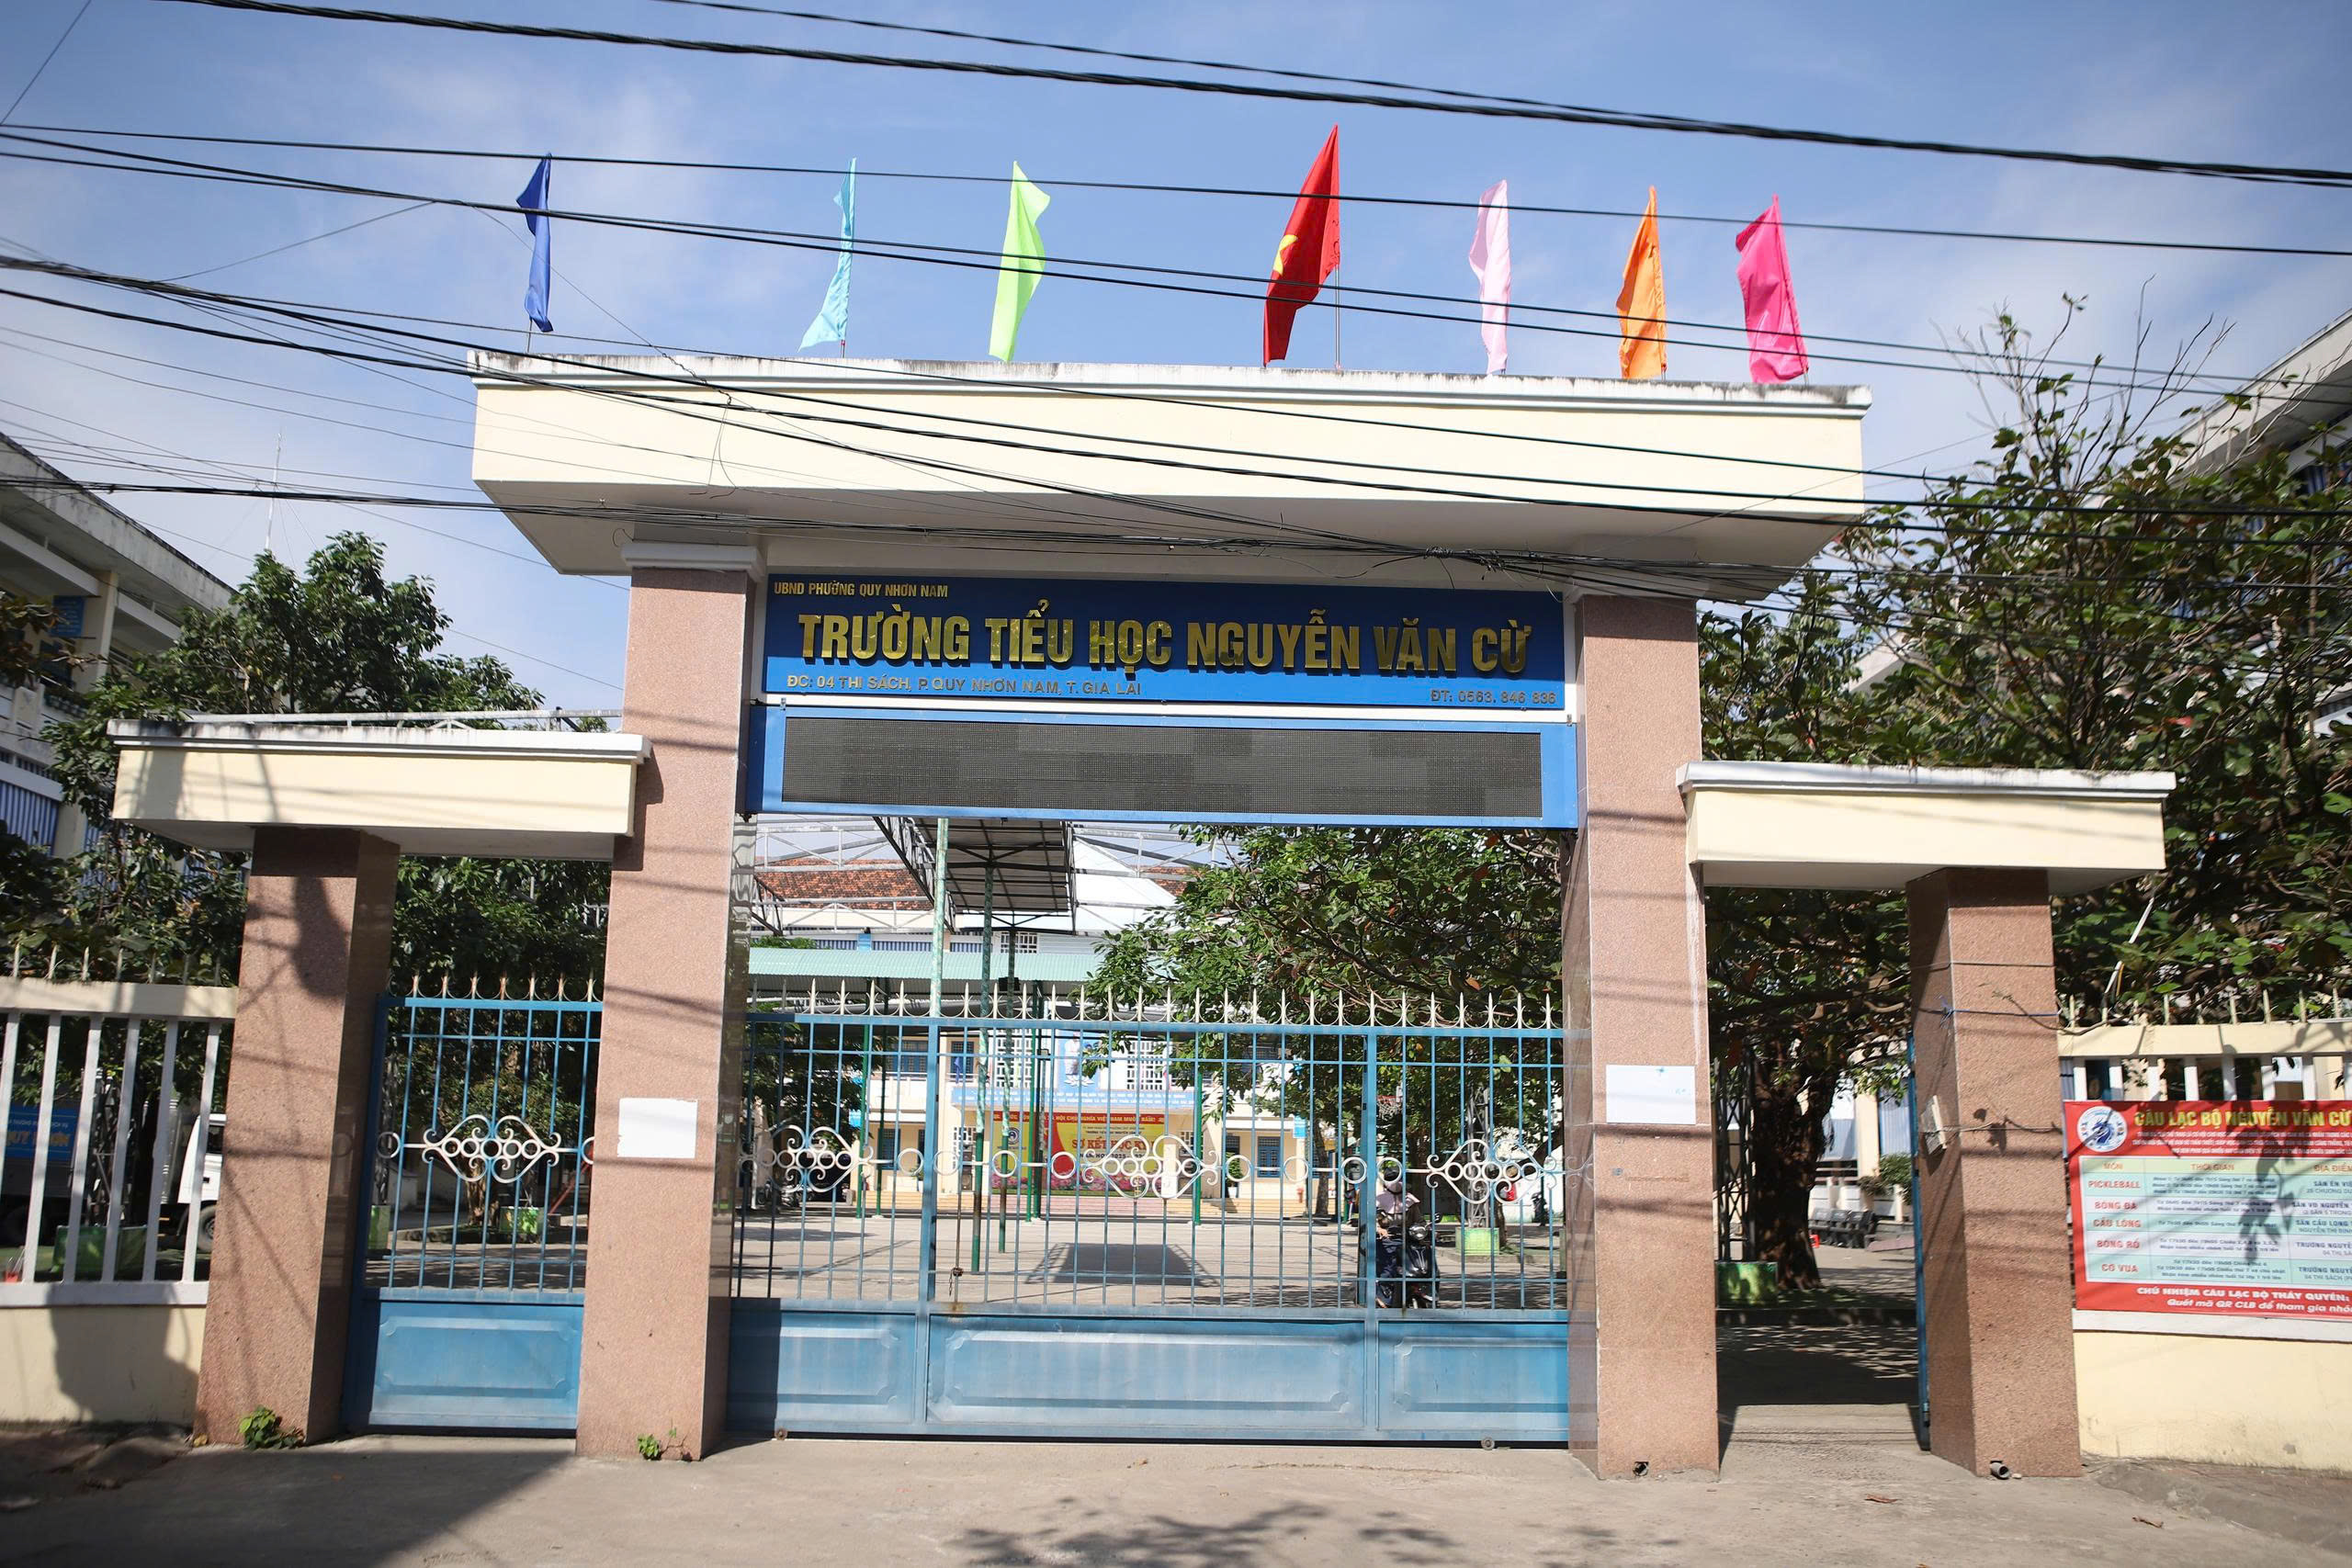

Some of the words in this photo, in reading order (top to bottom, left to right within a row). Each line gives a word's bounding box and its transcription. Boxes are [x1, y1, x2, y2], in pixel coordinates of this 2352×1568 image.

[775, 581, 805, 595] UBND
[808, 581, 855, 596] PHƯỜNG
[859, 583, 882, 597] QUY
[885, 583, 917, 597] NHƠN
[921, 585, 948, 598] NAM
[798, 604, 969, 660] TRƯỜNG
[985, 599, 1073, 663] TIỂU
[1089, 619, 1172, 674] HỌC
[1187, 608, 1360, 670] NGUYỄN
[1374, 617, 1456, 671] VĂN
[1472, 619, 1532, 673] CỪ
[786, 675, 813, 688] ĐC:
[817, 676, 835, 689] 04
[839, 678, 863, 690] THI
[867, 672, 912, 693] SÁCH,
[932, 677, 966, 692] QUY
[971, 678, 1016, 693] NHƠN
[1022, 681, 1062, 695] NAM,
[1082, 682, 1110, 694] GIA
[1116, 682, 1141, 695] LAI
[1430, 690, 1453, 702] ĐT:
[1501, 691, 1526, 705] 846
[1532, 692, 1556, 705] 836
[2168, 1111, 2198, 1130] LẠC
[2201, 1108, 2222, 1129] BỘ
[2292, 1109, 2324, 1126] VĂN
[2088, 1179, 2141, 1189] PICKLEBALL
[2276, 1303, 2304, 1311] tham
[2307, 1304, 2326, 1314] gia
